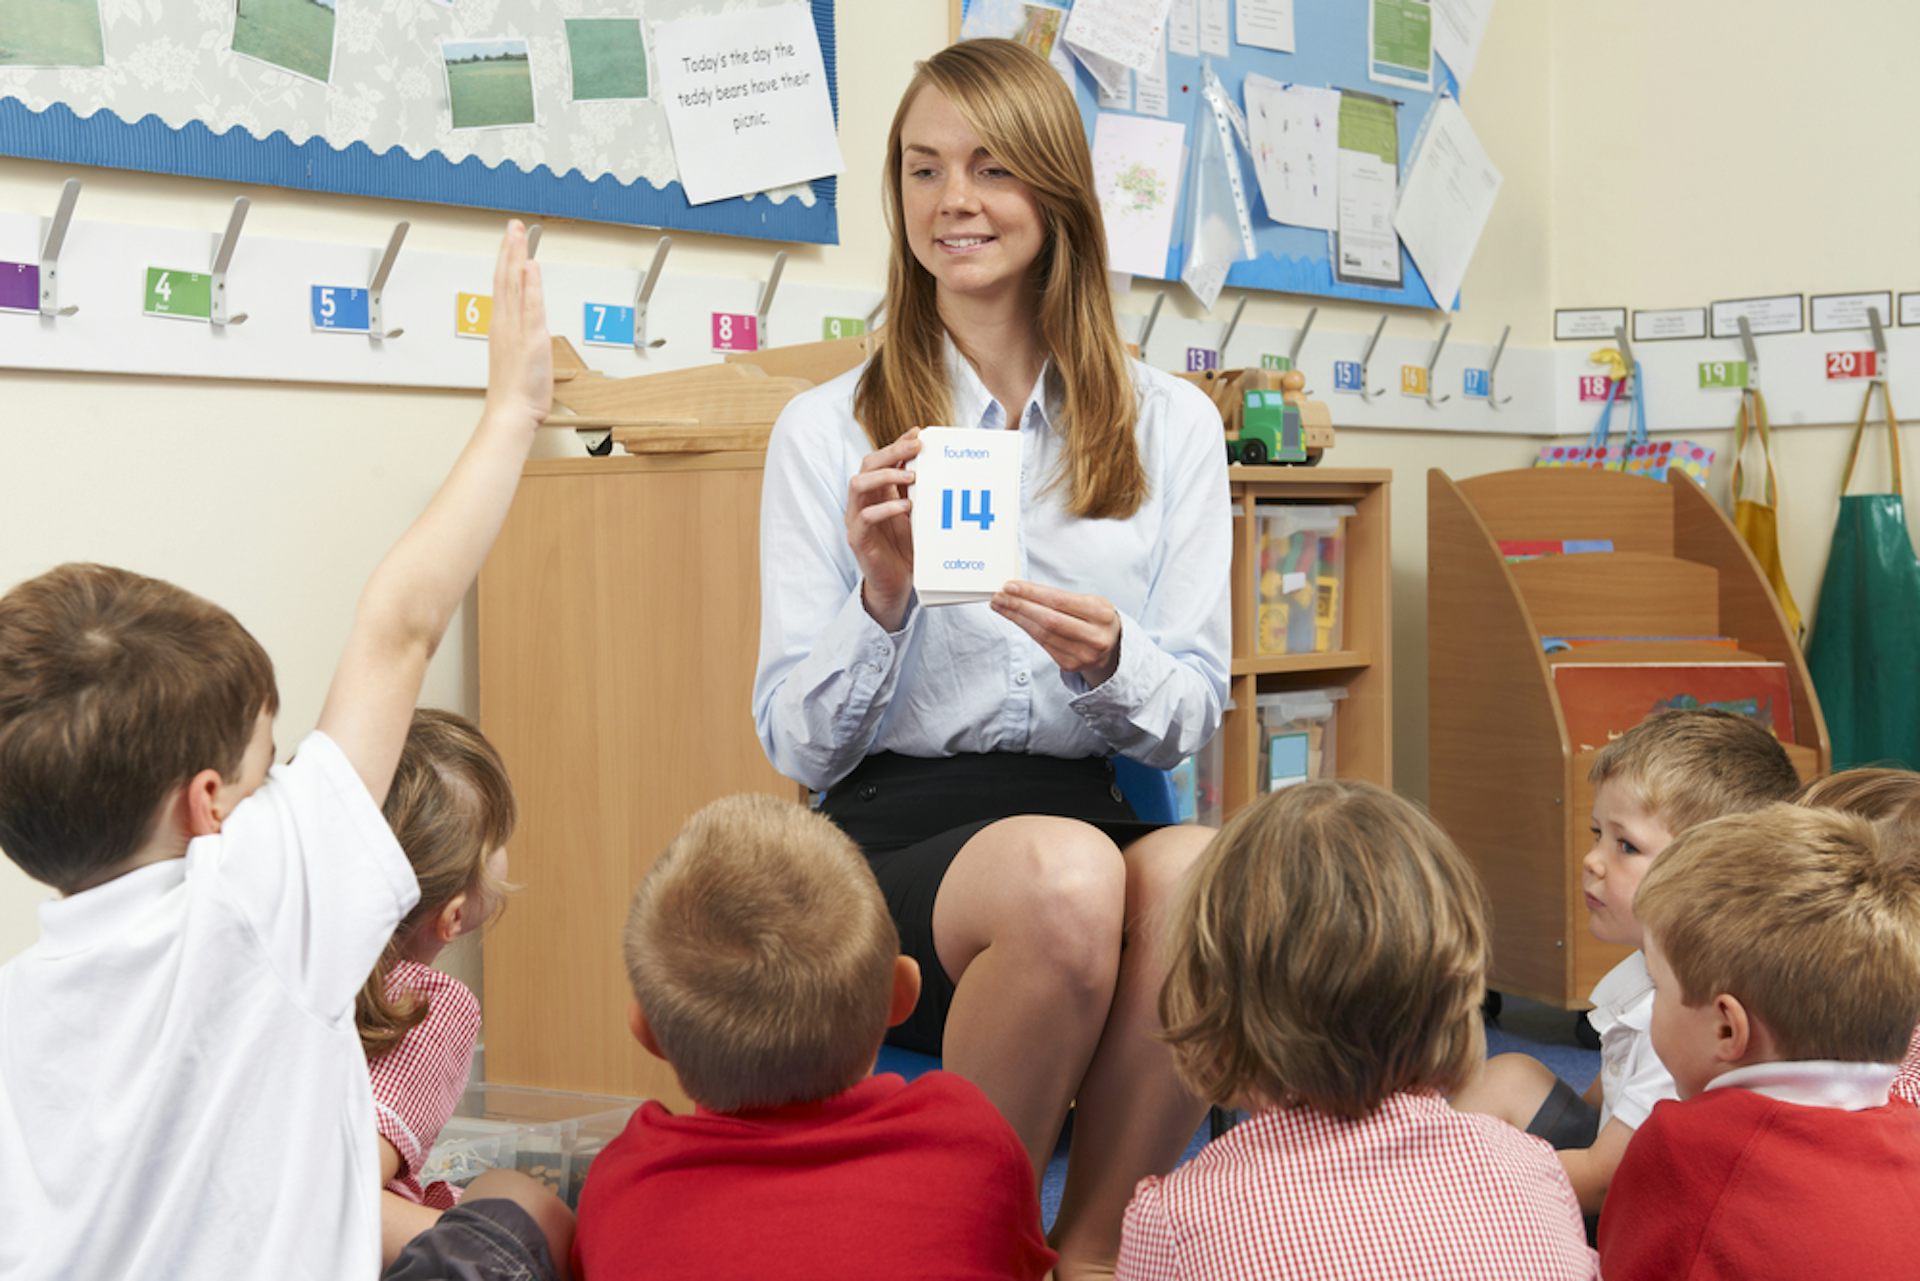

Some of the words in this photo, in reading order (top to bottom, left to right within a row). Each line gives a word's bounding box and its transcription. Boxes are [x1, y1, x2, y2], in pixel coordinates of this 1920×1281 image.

[682, 52, 728, 74] Today's
[730, 49, 750, 67] the
[752, 45, 772, 65] day
[774, 42, 796, 58] the
[678, 87, 713, 108] teddy
[715, 82, 750, 102] bears
[751, 78, 779, 95] have
[781, 71, 811, 88] their
[733, 112, 770, 134] picnic.
[155, 272, 172, 302] 4
[320, 288, 336, 318] 5
[466, 297, 480, 323] 6
[593, 306, 606, 332] 7
[719, 315, 733, 341] 8
[830, 319, 842, 340] 9
[1189, 349, 1206, 371] 13
[1829, 353, 1855, 372] 20
[1337, 363, 1353, 384] 15
[1405, 367, 1418, 387] 16
[1466, 370, 1479, 389] 17
[1703, 363, 1726, 382] 19
[1583, 377, 1605, 395] 18
[944, 446, 990, 459] fourteen
[941, 489, 995, 530] 14
[943, 558, 985, 570] catorce
